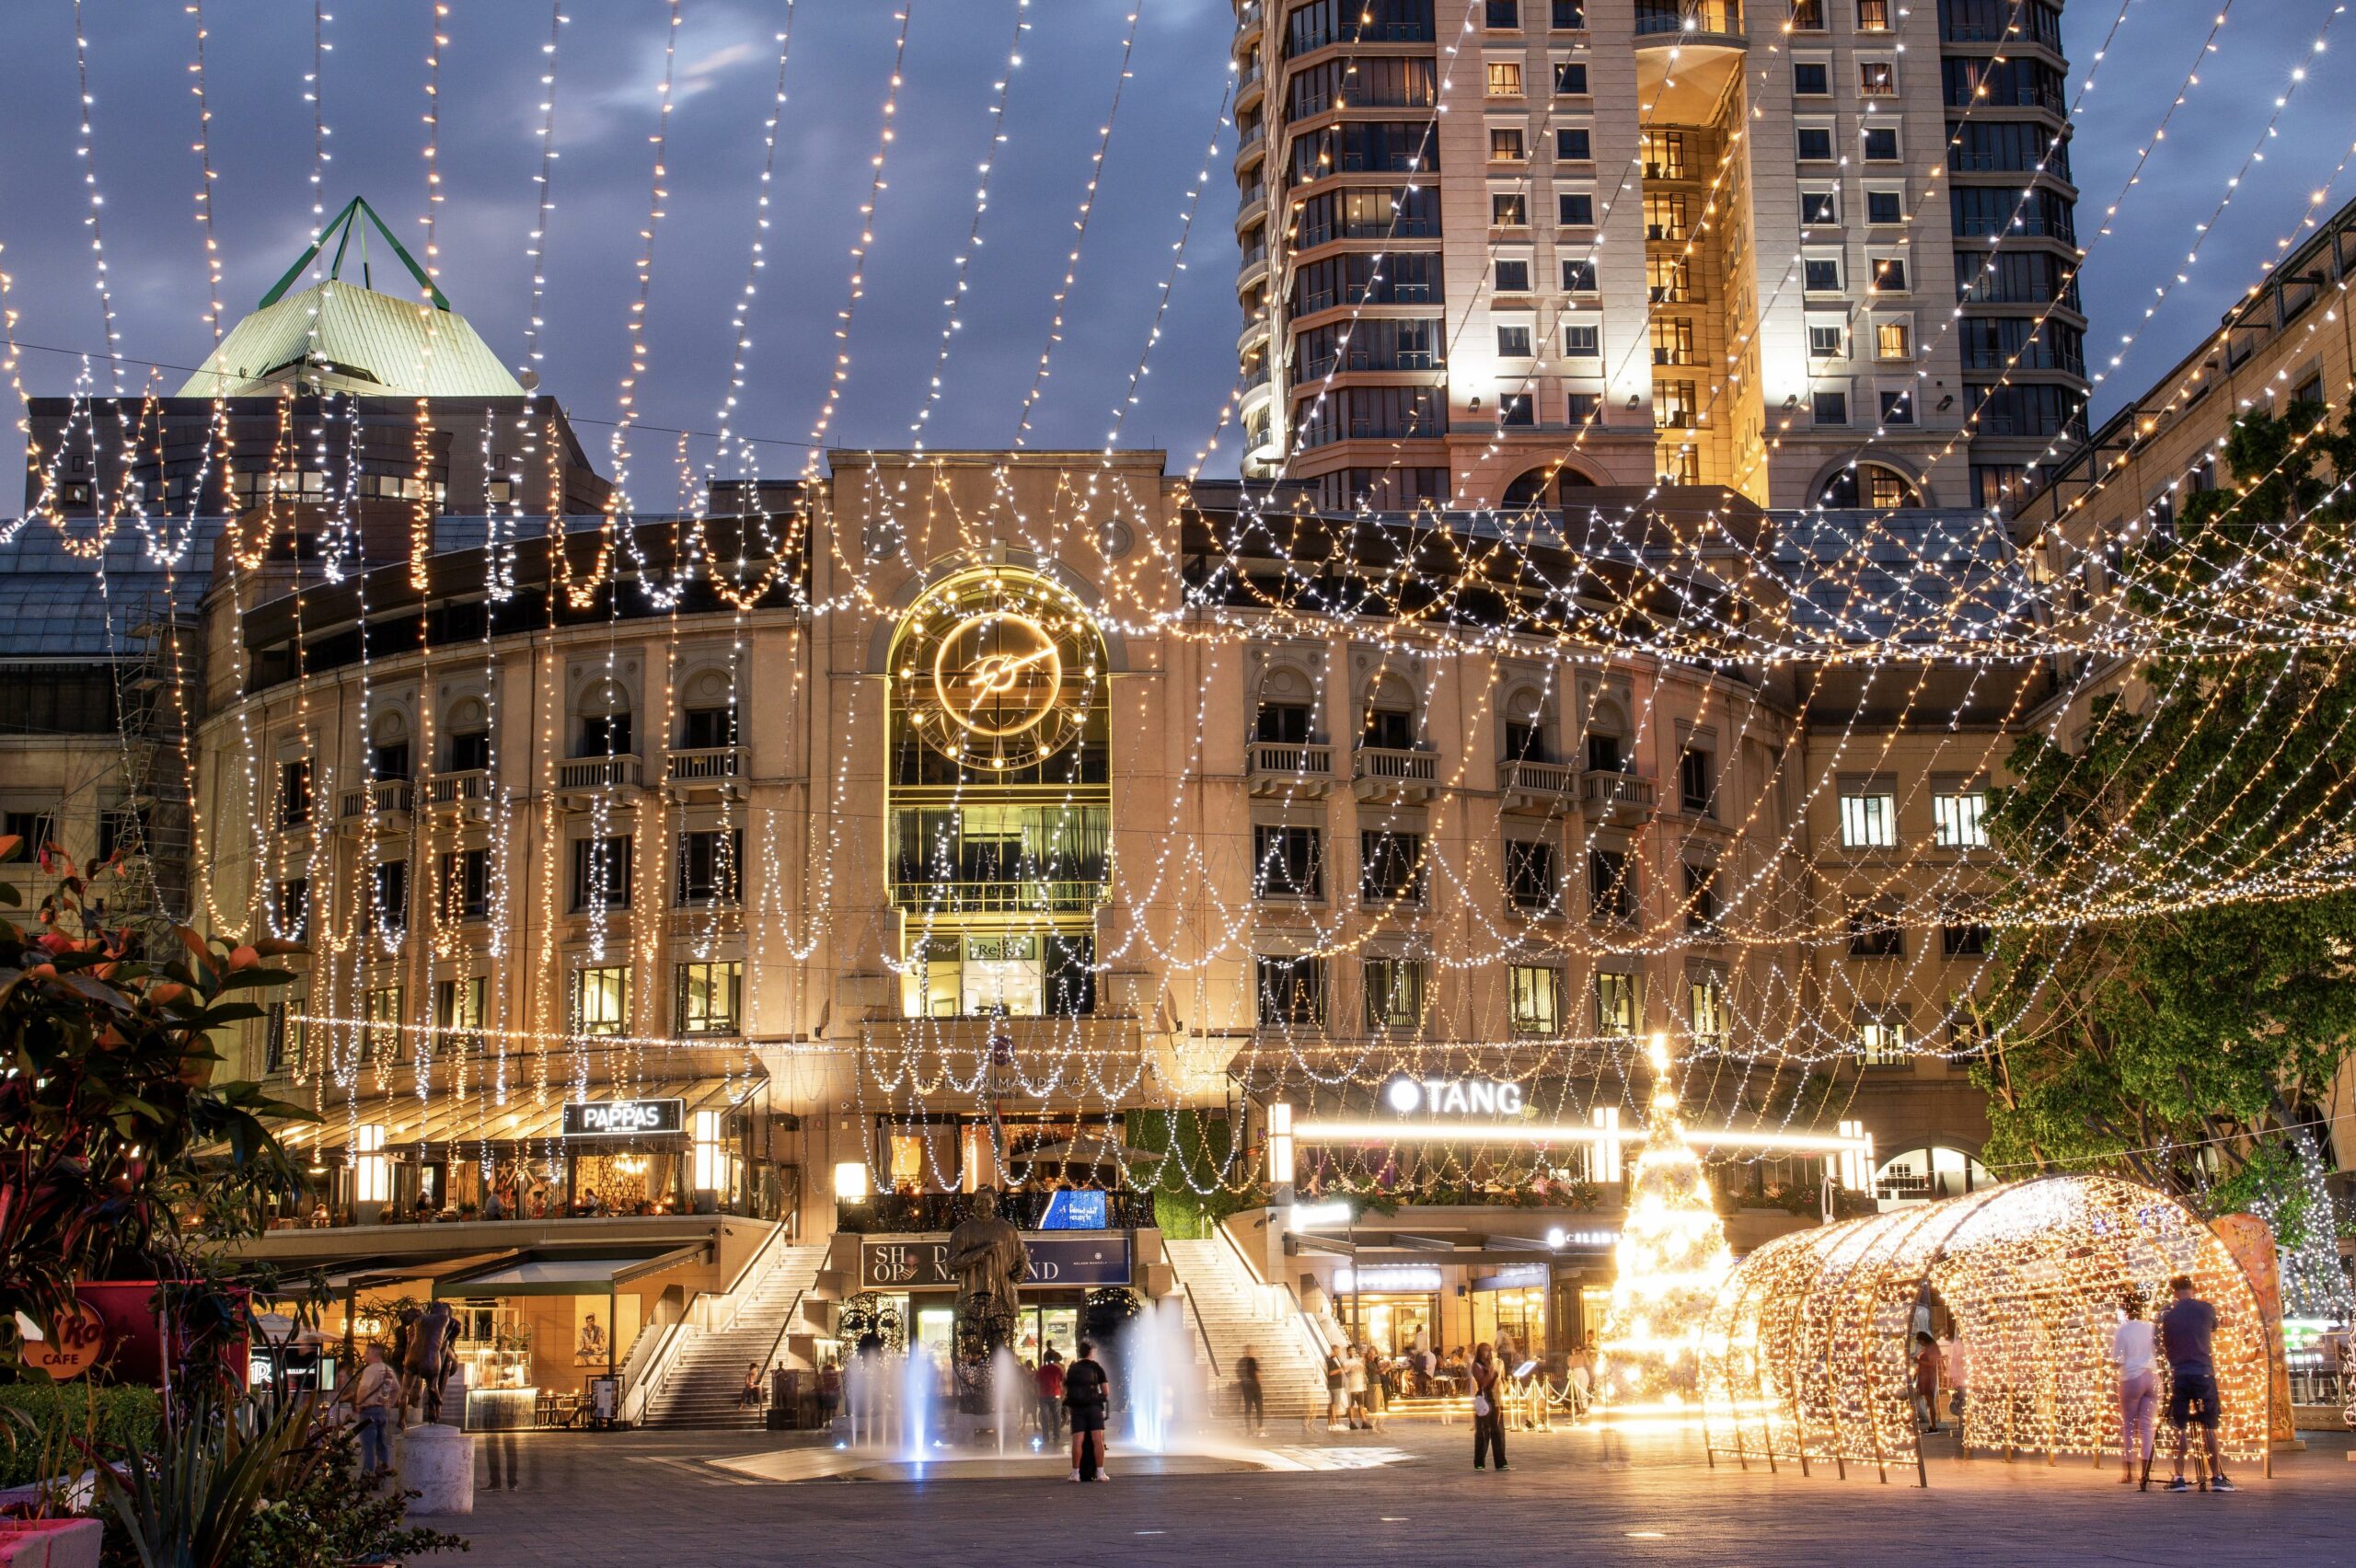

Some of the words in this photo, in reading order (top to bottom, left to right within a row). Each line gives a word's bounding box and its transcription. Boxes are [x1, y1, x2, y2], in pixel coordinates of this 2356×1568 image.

[978, 944, 1025, 958] Regus
[998, 1077, 1081, 1088] MANDLA
[1427, 1081, 1521, 1114] TANG
[583, 1106, 660, 1128] PAPPAS
[42, 1354, 79, 1366] CAFE
